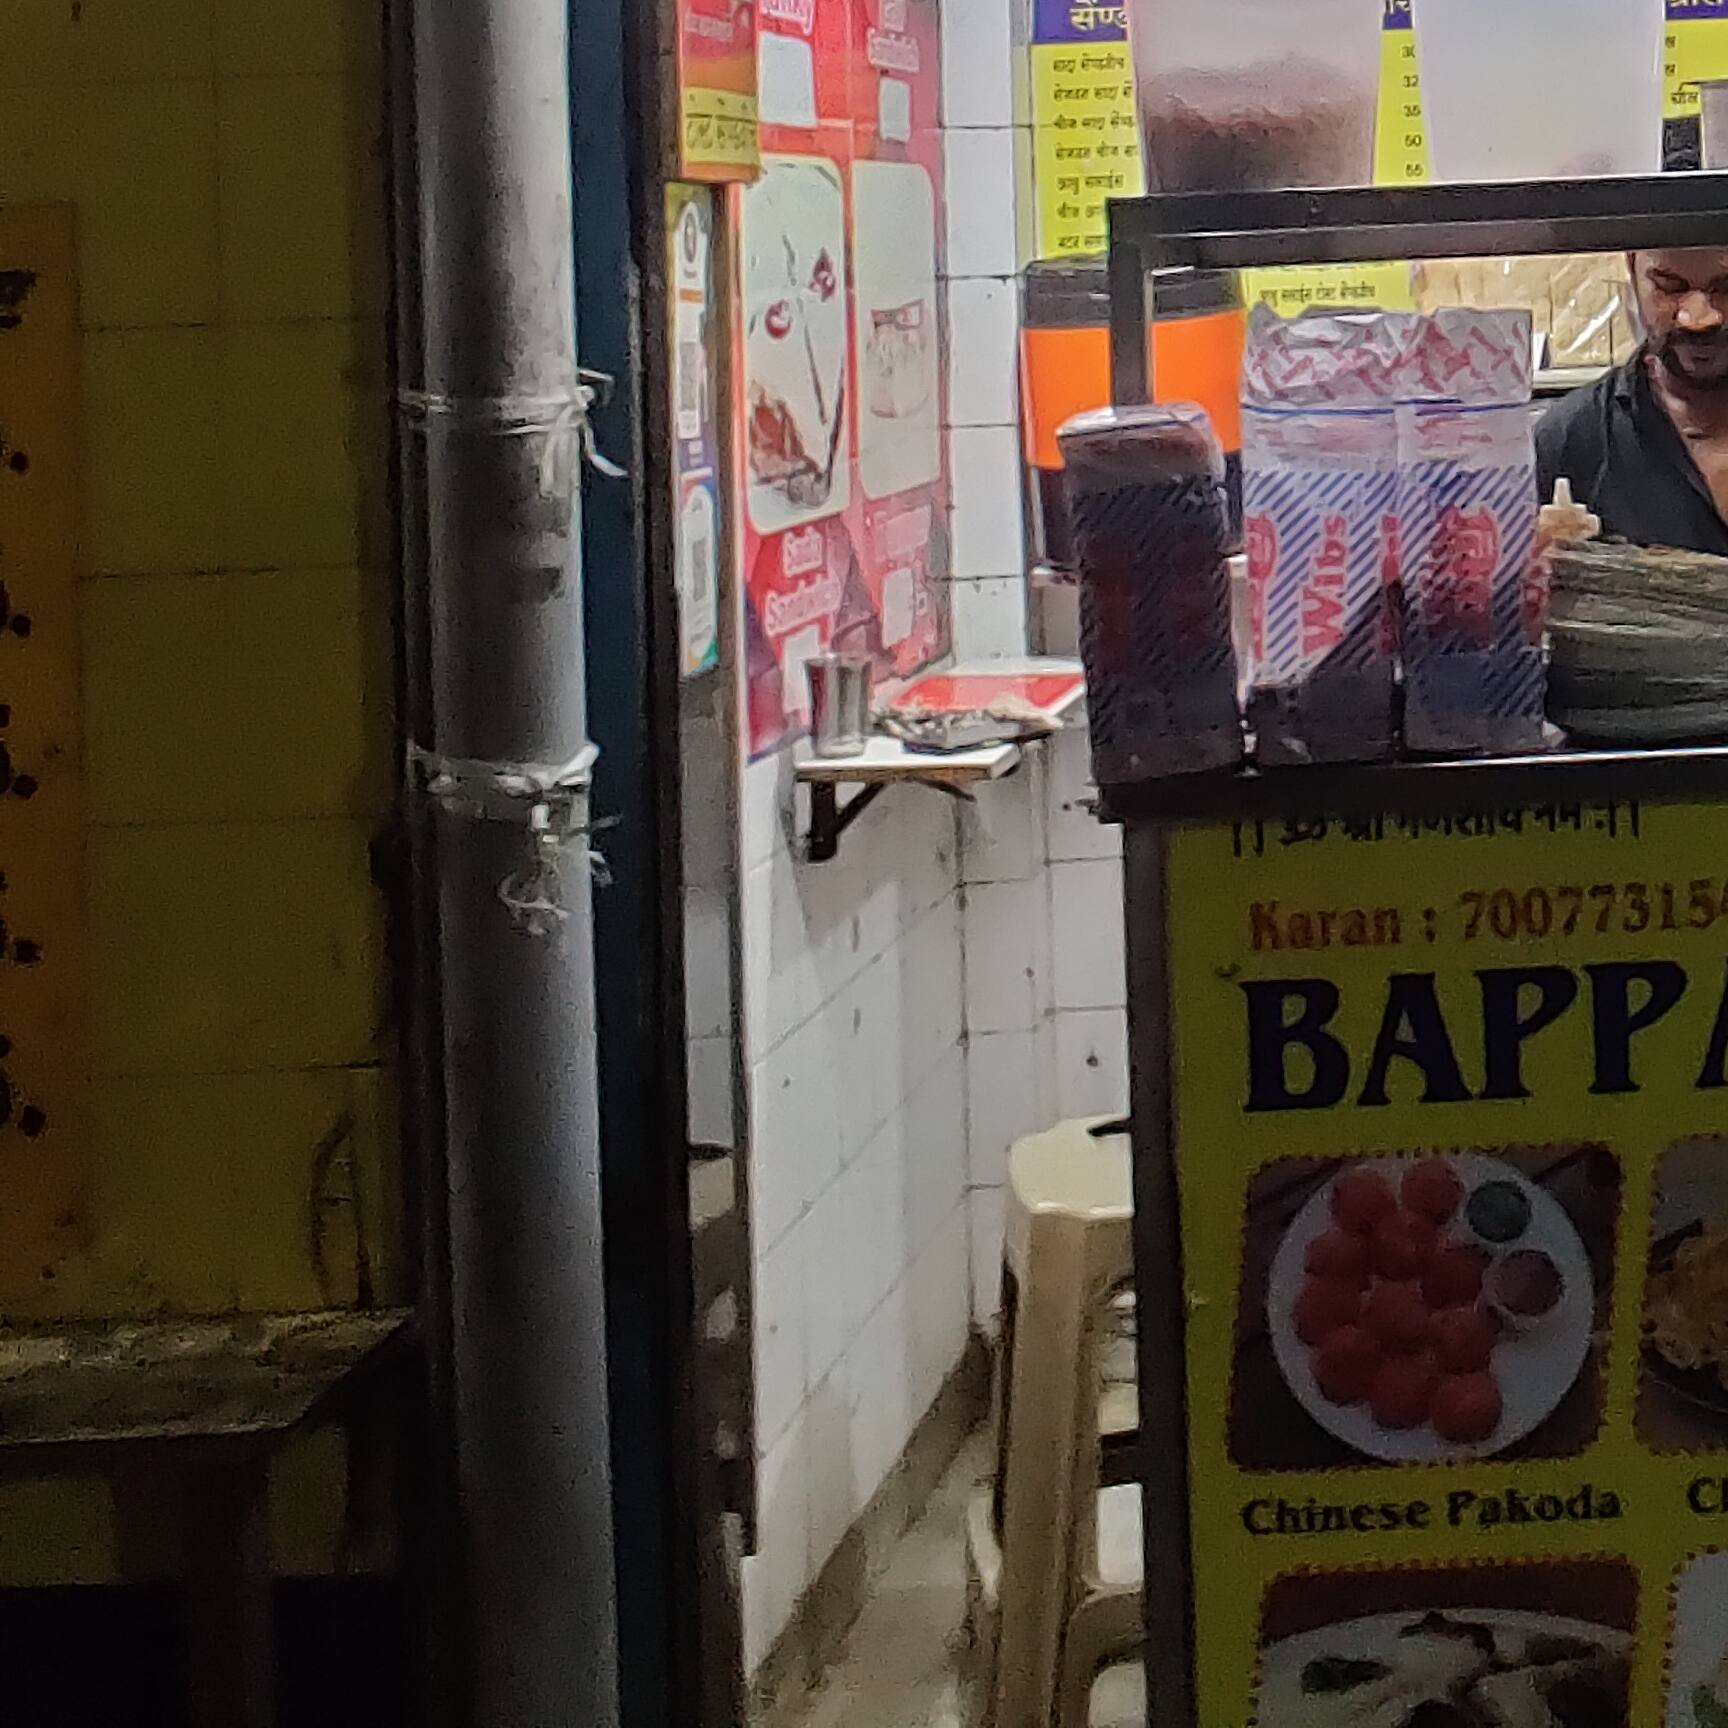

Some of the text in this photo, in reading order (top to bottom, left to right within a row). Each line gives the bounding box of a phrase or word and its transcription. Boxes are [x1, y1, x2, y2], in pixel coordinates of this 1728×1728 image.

[1248, 902, 1400, 951] Karan
[1241, 1484, 1622, 1537] Chinese Pakoda
